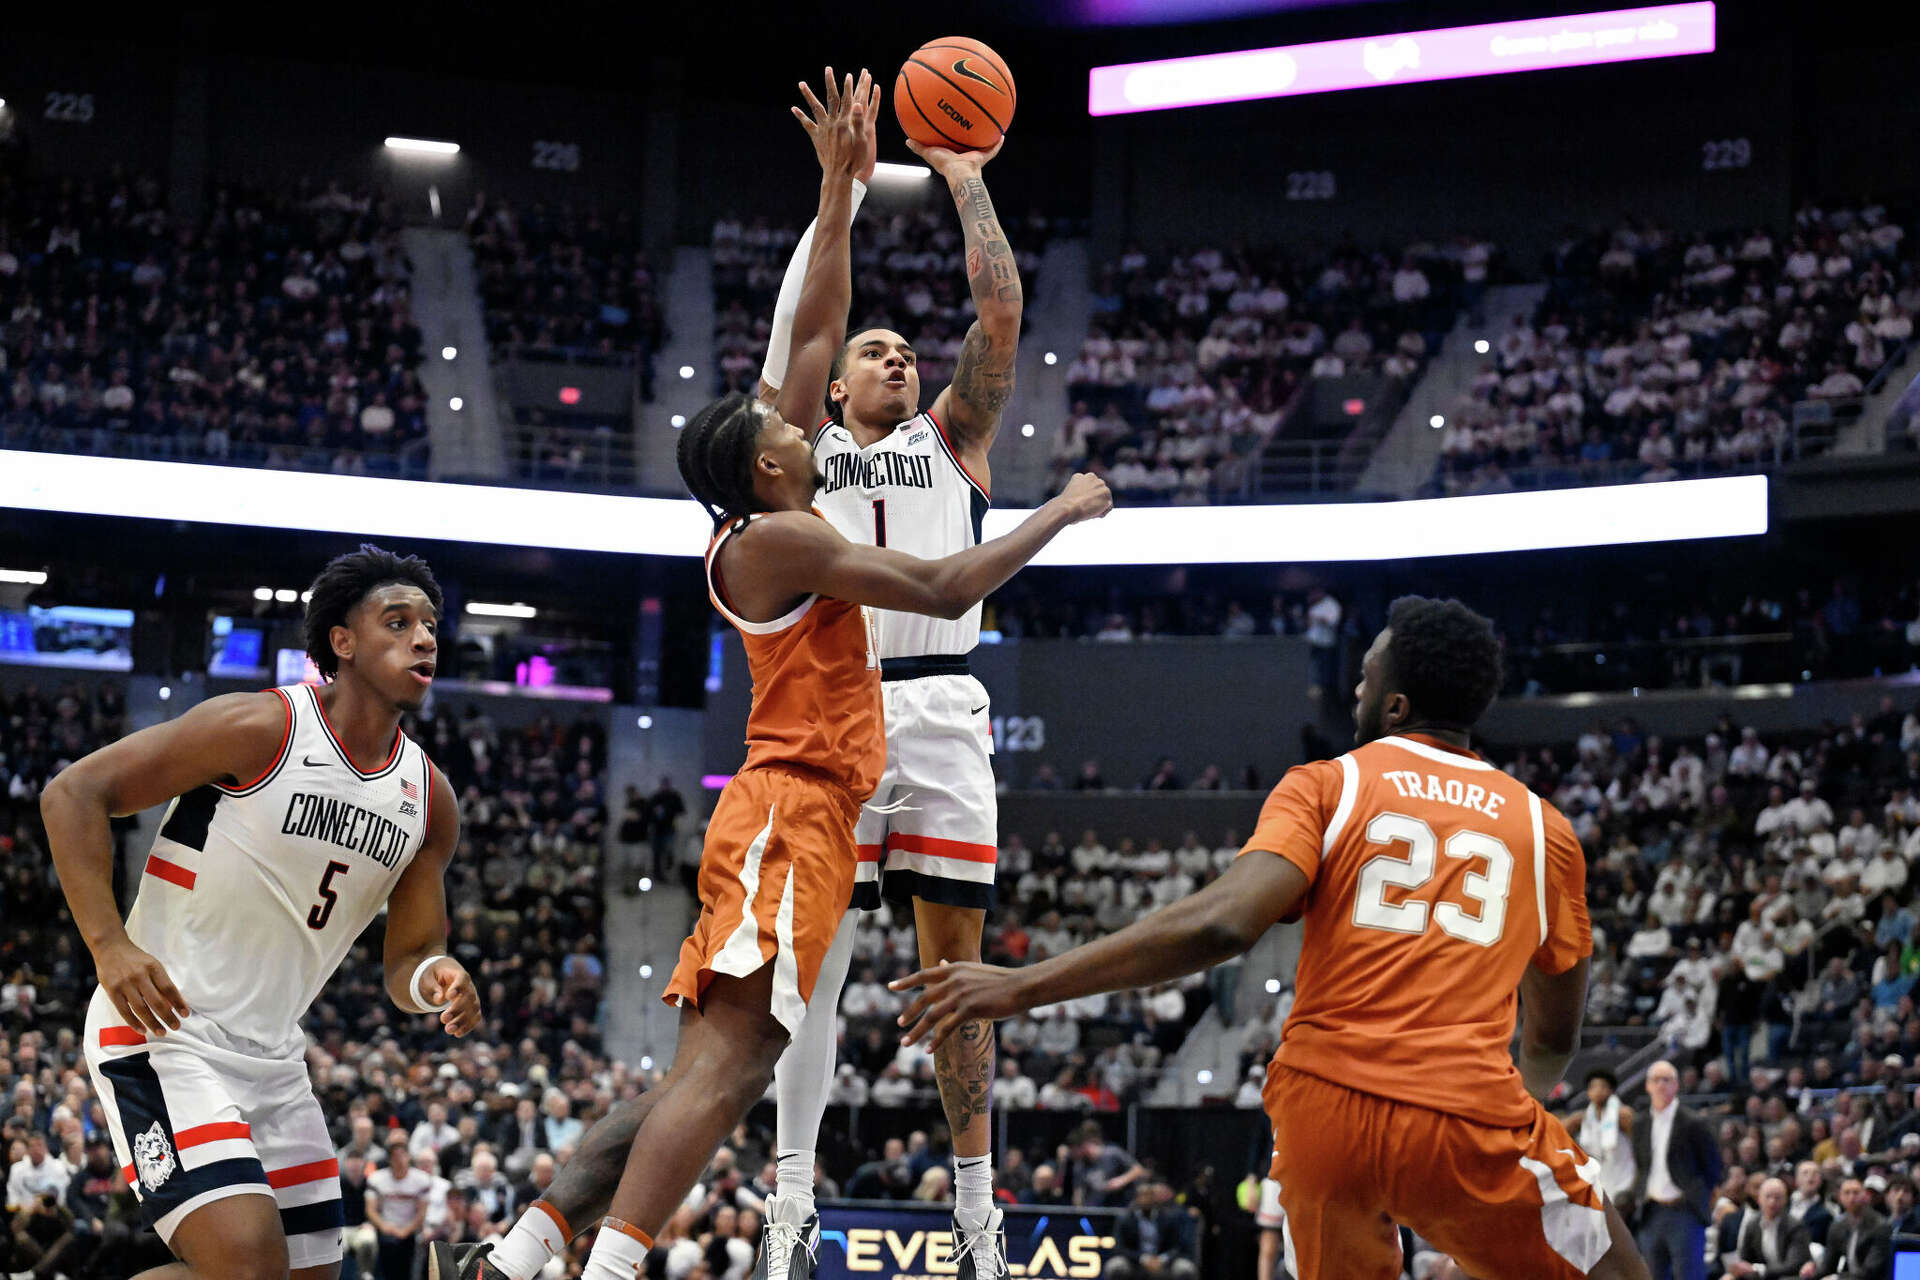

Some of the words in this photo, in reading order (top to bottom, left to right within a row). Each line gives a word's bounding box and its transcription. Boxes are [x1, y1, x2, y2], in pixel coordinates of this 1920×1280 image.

[45, 91, 94, 123] 225
[937, 98, 973, 130] UCONN
[825, 451, 933, 494] CONNECTICUT
[872, 499, 887, 548] 1
[992, 715, 1044, 751] 123
[1382, 770, 1506, 820] TRAORE
[281, 792, 410, 872] CONNECTICUT
[306, 859, 350, 930] 5
[1352, 811, 1514, 947] 23
